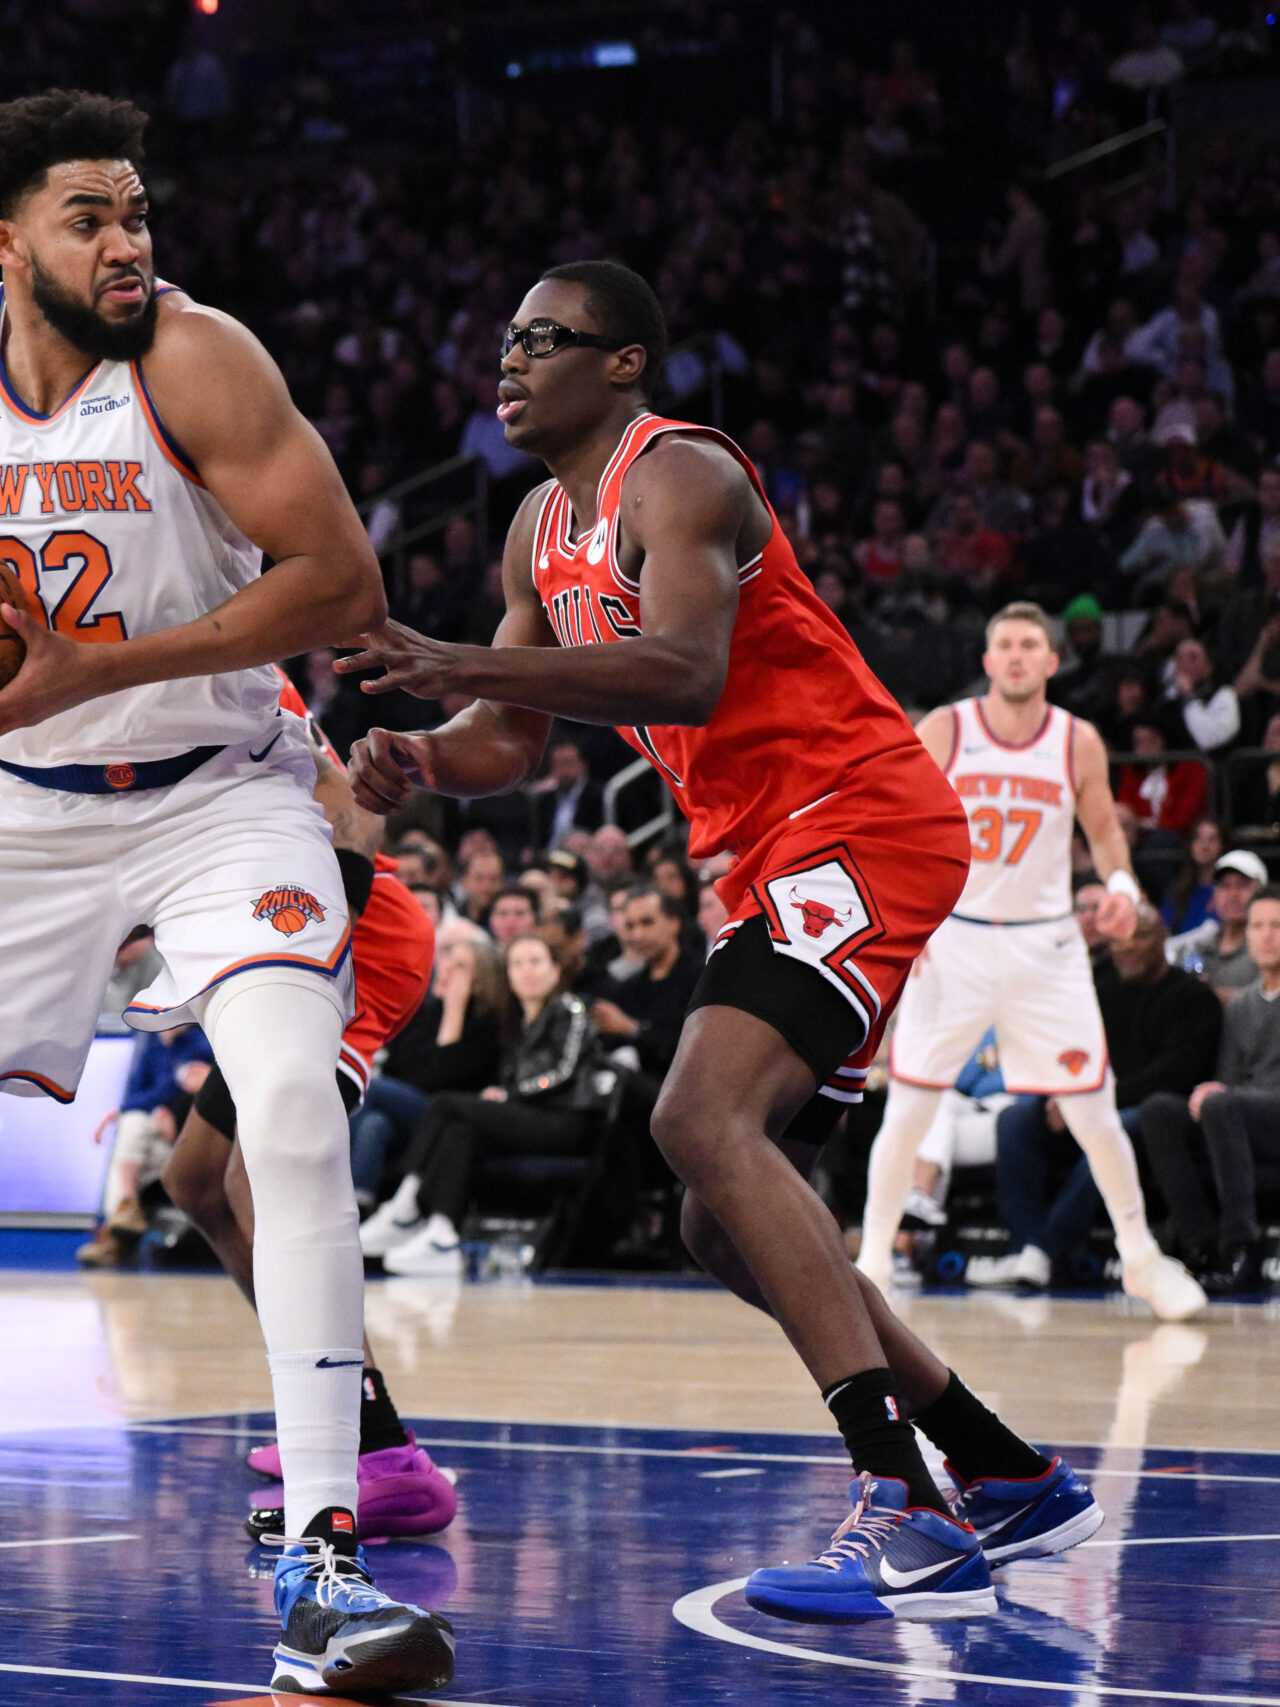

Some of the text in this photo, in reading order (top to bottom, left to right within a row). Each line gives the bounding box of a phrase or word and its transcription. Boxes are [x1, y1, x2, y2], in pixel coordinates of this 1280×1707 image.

[80, 392, 131, 417] abu dhabi
[32, 461, 153, 513] YORK
[542, 585, 643, 648] ULLS
[954, 772, 1064, 809] NEW YORK
[970, 806, 1044, 867] 37
[252, 890, 326, 923] KNICKS
